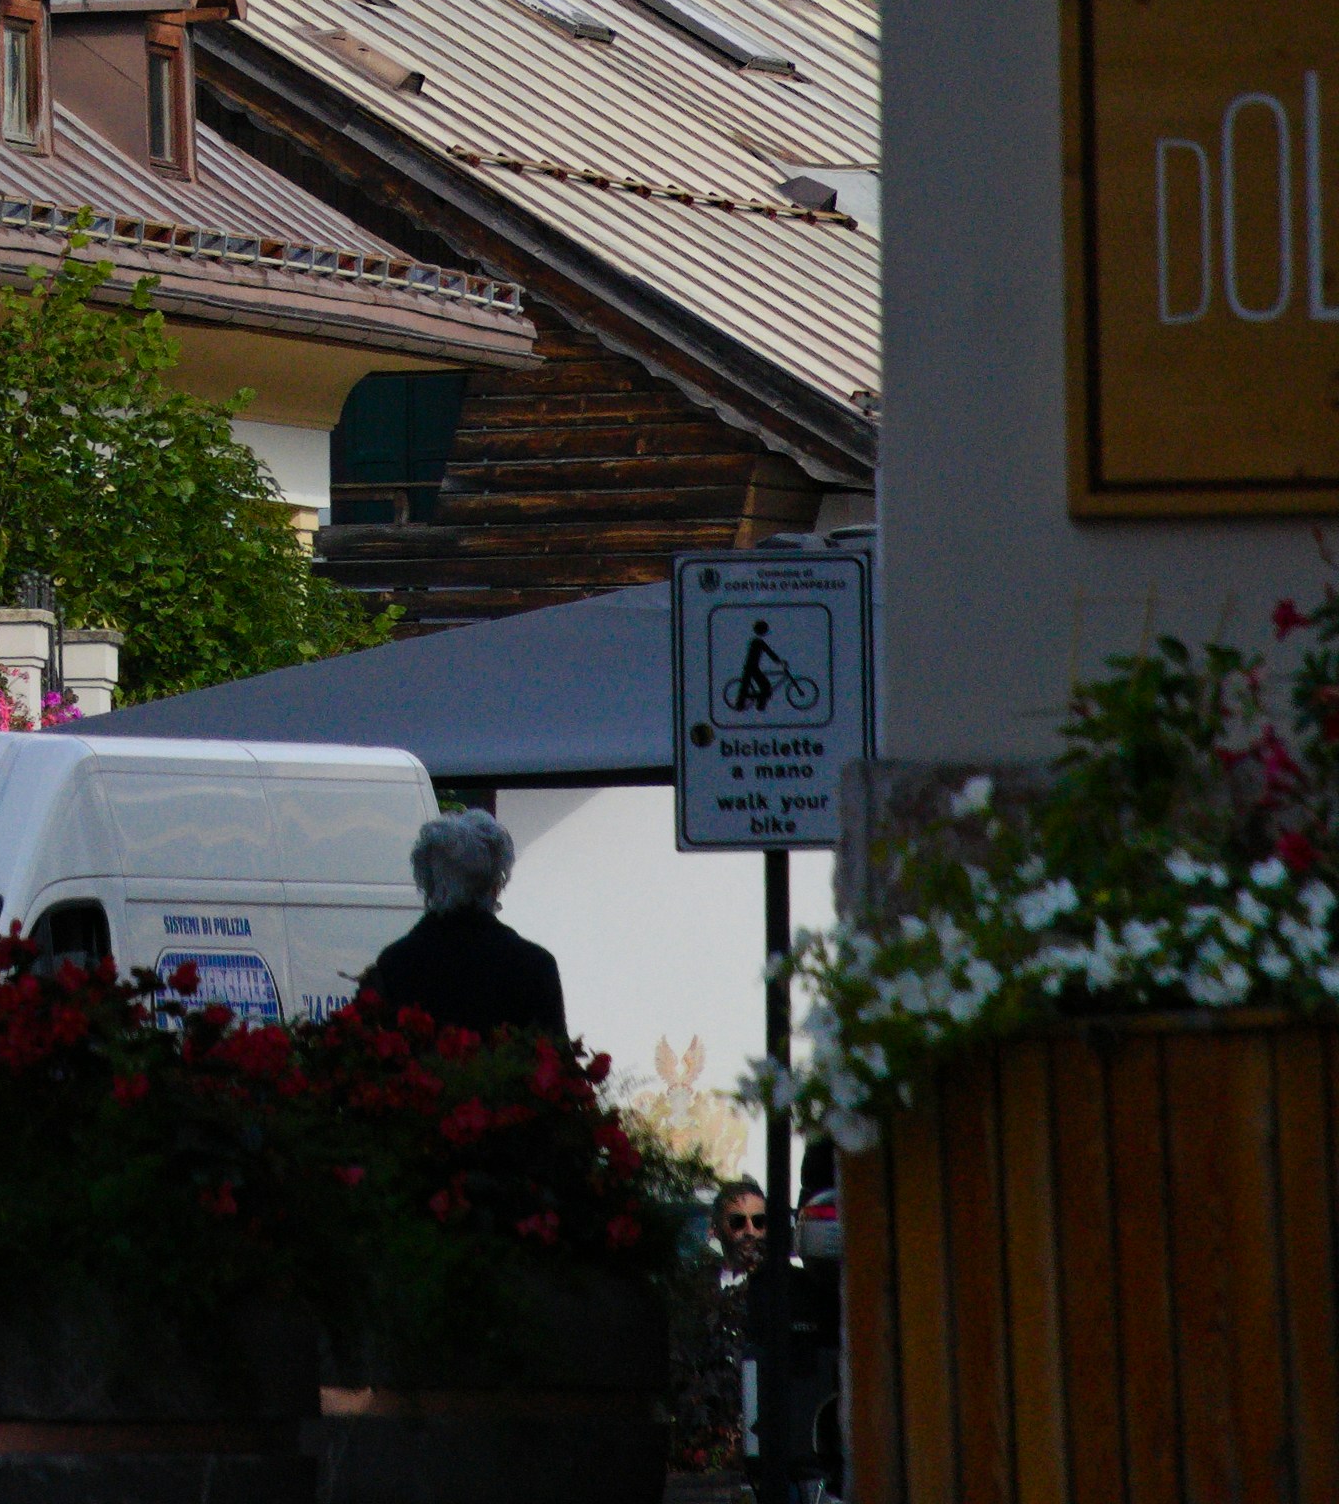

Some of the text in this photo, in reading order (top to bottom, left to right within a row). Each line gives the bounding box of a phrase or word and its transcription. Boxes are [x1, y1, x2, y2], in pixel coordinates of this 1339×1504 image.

[720, 738, 824, 757] biciclette
[732, 764, 813, 779] a mano
[717, 794, 829, 814] walk your
[750, 818, 796, 836] bike
[164, 915, 252, 938] SISTEMI DI PULIZIA
